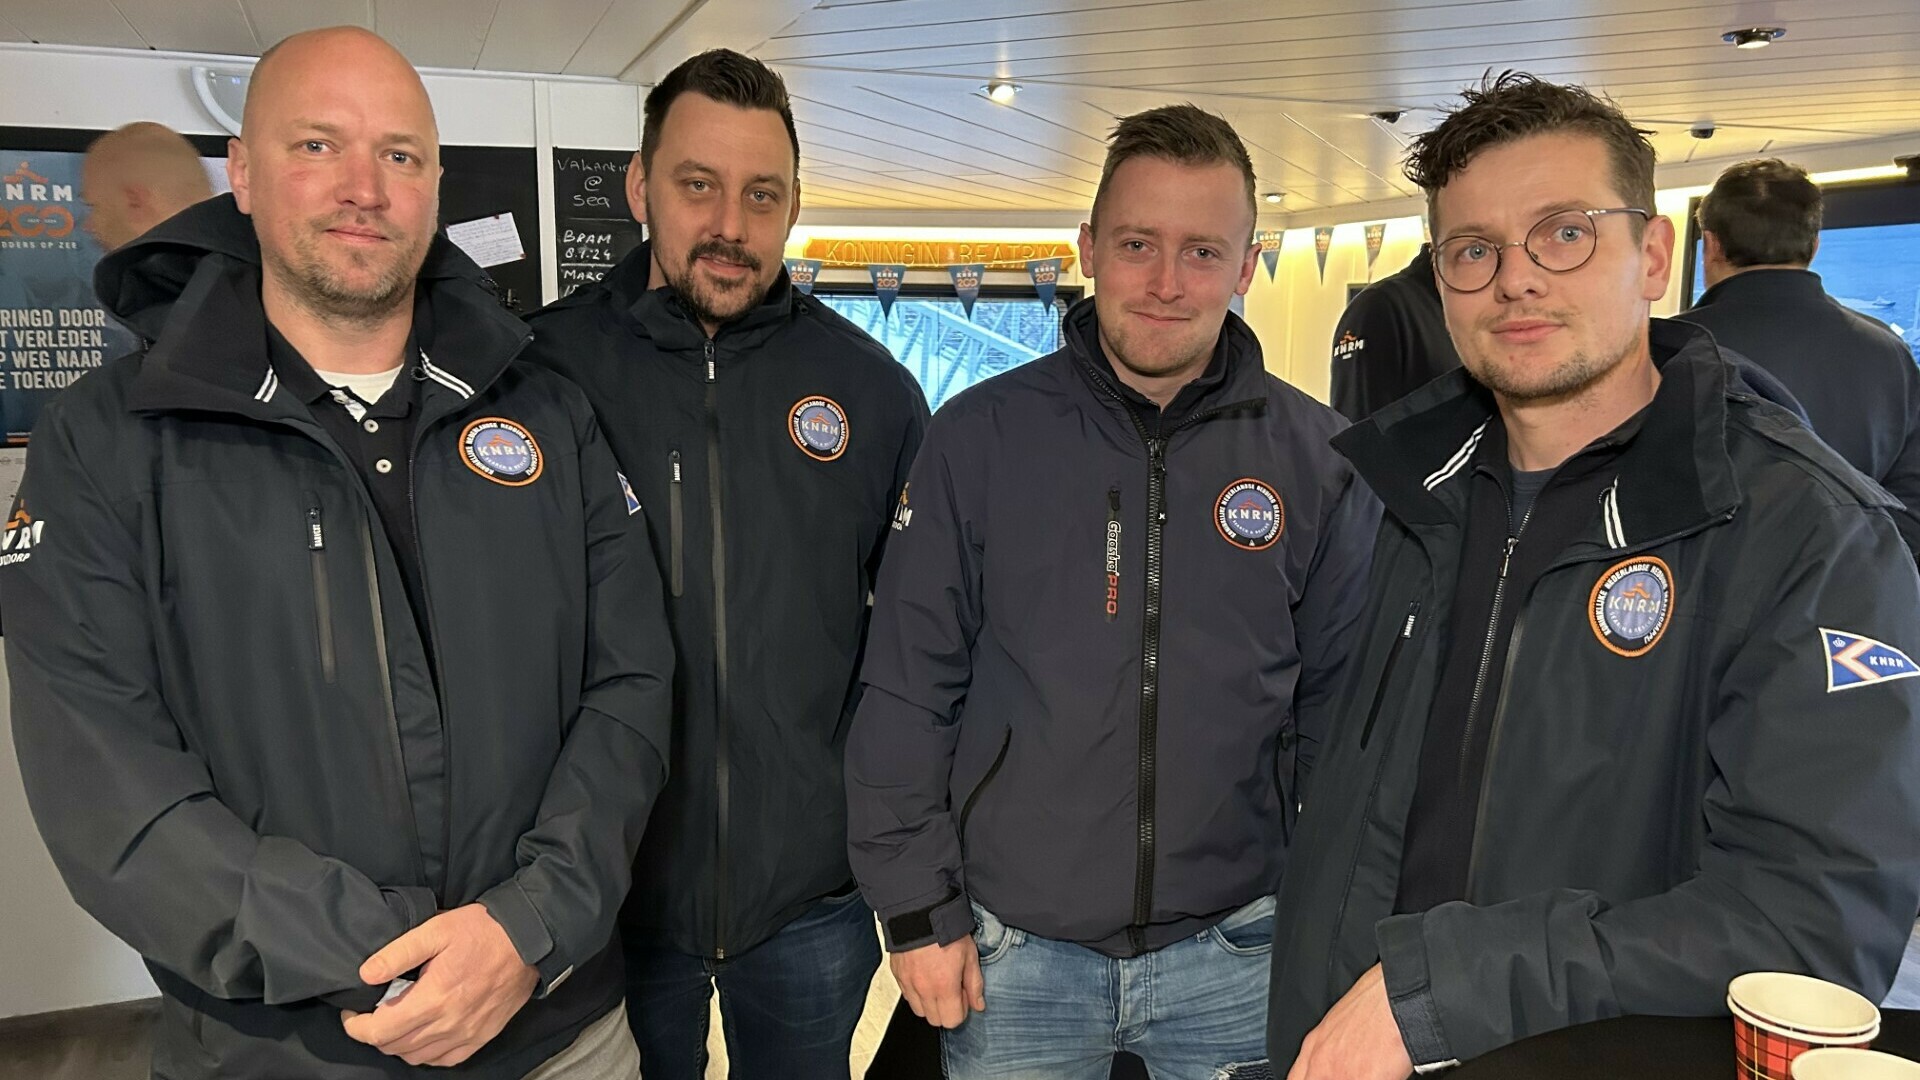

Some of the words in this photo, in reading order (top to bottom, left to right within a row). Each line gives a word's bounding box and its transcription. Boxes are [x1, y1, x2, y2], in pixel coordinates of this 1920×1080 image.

[0, 183, 73, 202] NRM
[584, 175, 603, 192] @
[563, 229, 612, 244] BRAM
[826, 241, 940, 267] KONINGIN
[59, 308, 106, 327] DOOR
[13, 329, 107, 348] VERLEDEN.
[1333, 339, 1364, 357] KNRM
[11, 350, 51, 369] WEG
[56, 350, 103, 368] NAAR
[10, 370, 89, 390] TOEKOM
[801, 420, 838, 436] KNRM
[477, 445, 528, 458] KNRM
[1227, 508, 1272, 521] KNRM
[1106, 574, 1120, 615] PRO
[1608, 595, 1661, 614] KNRM
